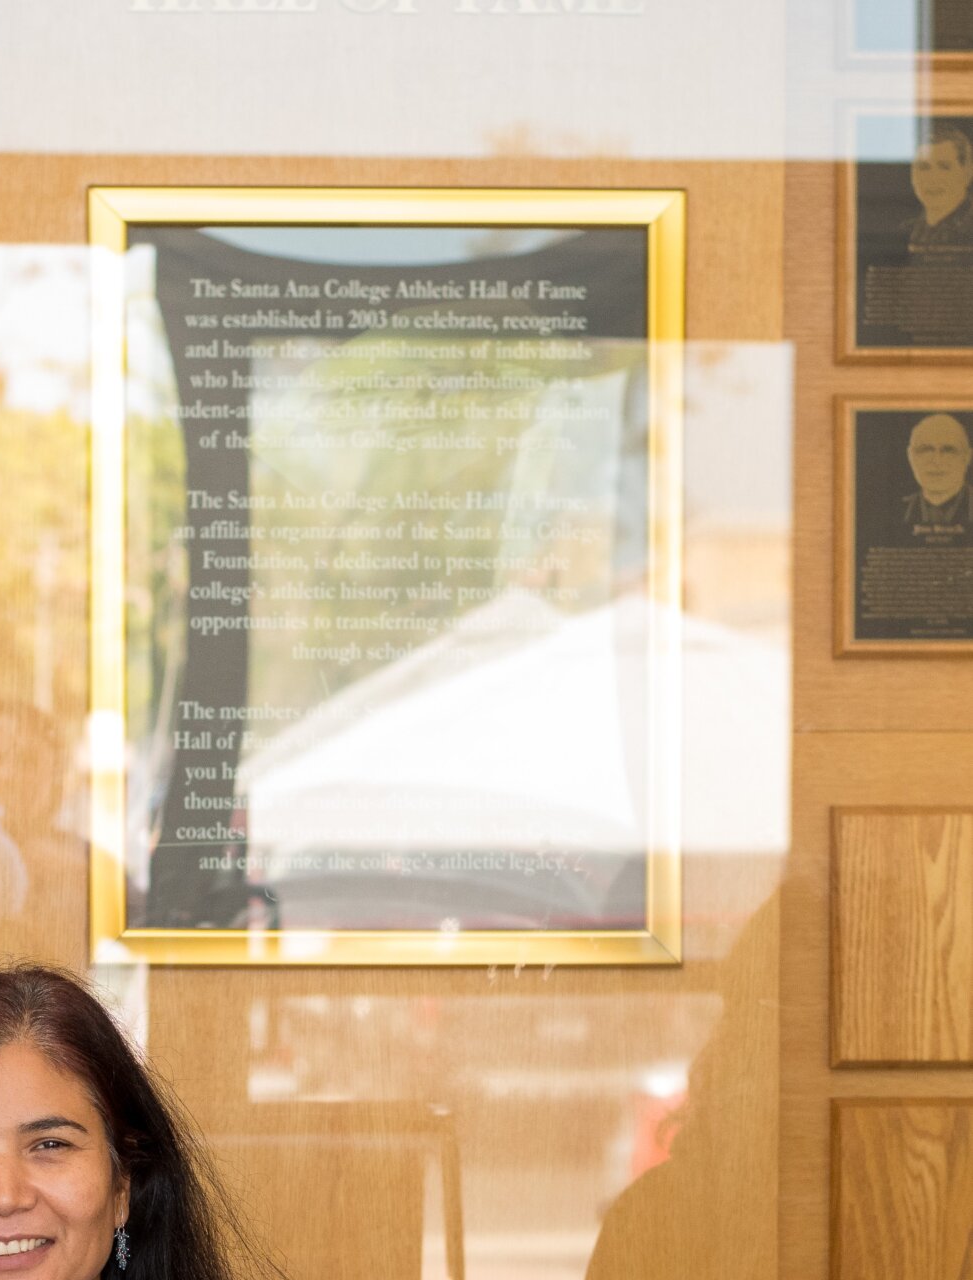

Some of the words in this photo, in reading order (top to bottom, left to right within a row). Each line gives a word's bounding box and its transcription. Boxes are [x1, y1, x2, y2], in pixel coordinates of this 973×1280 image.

[189, 278, 226, 298] The
[230, 278, 279, 298] Santa
[284, 279, 320, 298] Ana
[325, 279, 392, 305] College
[395, 280, 464, 299] Athletic
[469, 280, 508, 299] Hall
[511, 280, 532, 299] of
[538, 280, 588, 300] Fame
[184, 314, 218, 328] was
[222, 309, 321, 328] established
[326, 310, 343, 328] in
[348, 309, 387, 328] 2003
[392, 312, 410, 329] to
[413, 310, 499, 333] celebrate,
[502, 311, 588, 335] recognize
[185, 339, 218, 358] and
[223, 339, 276, 358] honor
[279, 340, 307, 358] the
[310, 340, 466, 363] accomplishments
[469, 340, 490, 359] of
[495, 340, 593, 360] individuals
[190, 370, 227, 389] who
[231, 370, 271, 389] have
[328, 370, 423, 394] significant
[427, 371, 545, 390] contributions
[385, 400, 436, 419] friend
[440, 402, 459, 419] to
[464, 400, 492, 419] the
[495, 400, 529, 419] rich
[199, 430, 220, 449] of
[225, 431, 252, 449] the
[350, 431, 417, 455] College
[422, 432, 487, 450] athletic
[187, 490, 222, 509] The
[227, 490, 276, 509] Santa
[281, 490, 317, 509] Ana
[321, 490, 387, 514] College
[390, 491, 461, 510] Athletic
[466, 491, 504, 510] Hall
[200, 520, 266, 539] affiliate
[270, 521, 381, 545] organization
[385, 522, 405, 540] of
[411, 522, 439, 540] the
[443, 522, 492, 540] Santa
[202, 551, 310, 573] Foundation,
[314, 552, 328, 569] is
[333, 551, 418, 570] dedicated
[424, 554, 441, 570] to
[445, 552, 538, 576] preserving
[542, 552, 571, 570] the
[190, 582, 266, 606] college's
[270, 582, 336, 600] athletic
[340, 582, 401, 606] history
[406, 582, 452, 600] while
[190, 611, 308, 636] opportunities
[314, 614, 332, 631] to
[336, 611, 438, 634] transferring
[292, 642, 361, 665] through
[179, 701, 215, 719] The
[220, 702, 300, 720] members
[173, 731, 211, 750] Hall
[216, 731, 237, 750] of
[185, 766, 217, 786] you
[176, 822, 246, 840] coaches
[199, 852, 232, 871] and
[328, 853, 355, 871] the
[360, 852, 434, 876] college's
[440, 852, 505, 871] athletic
[509, 852, 569, 877] legacy.
